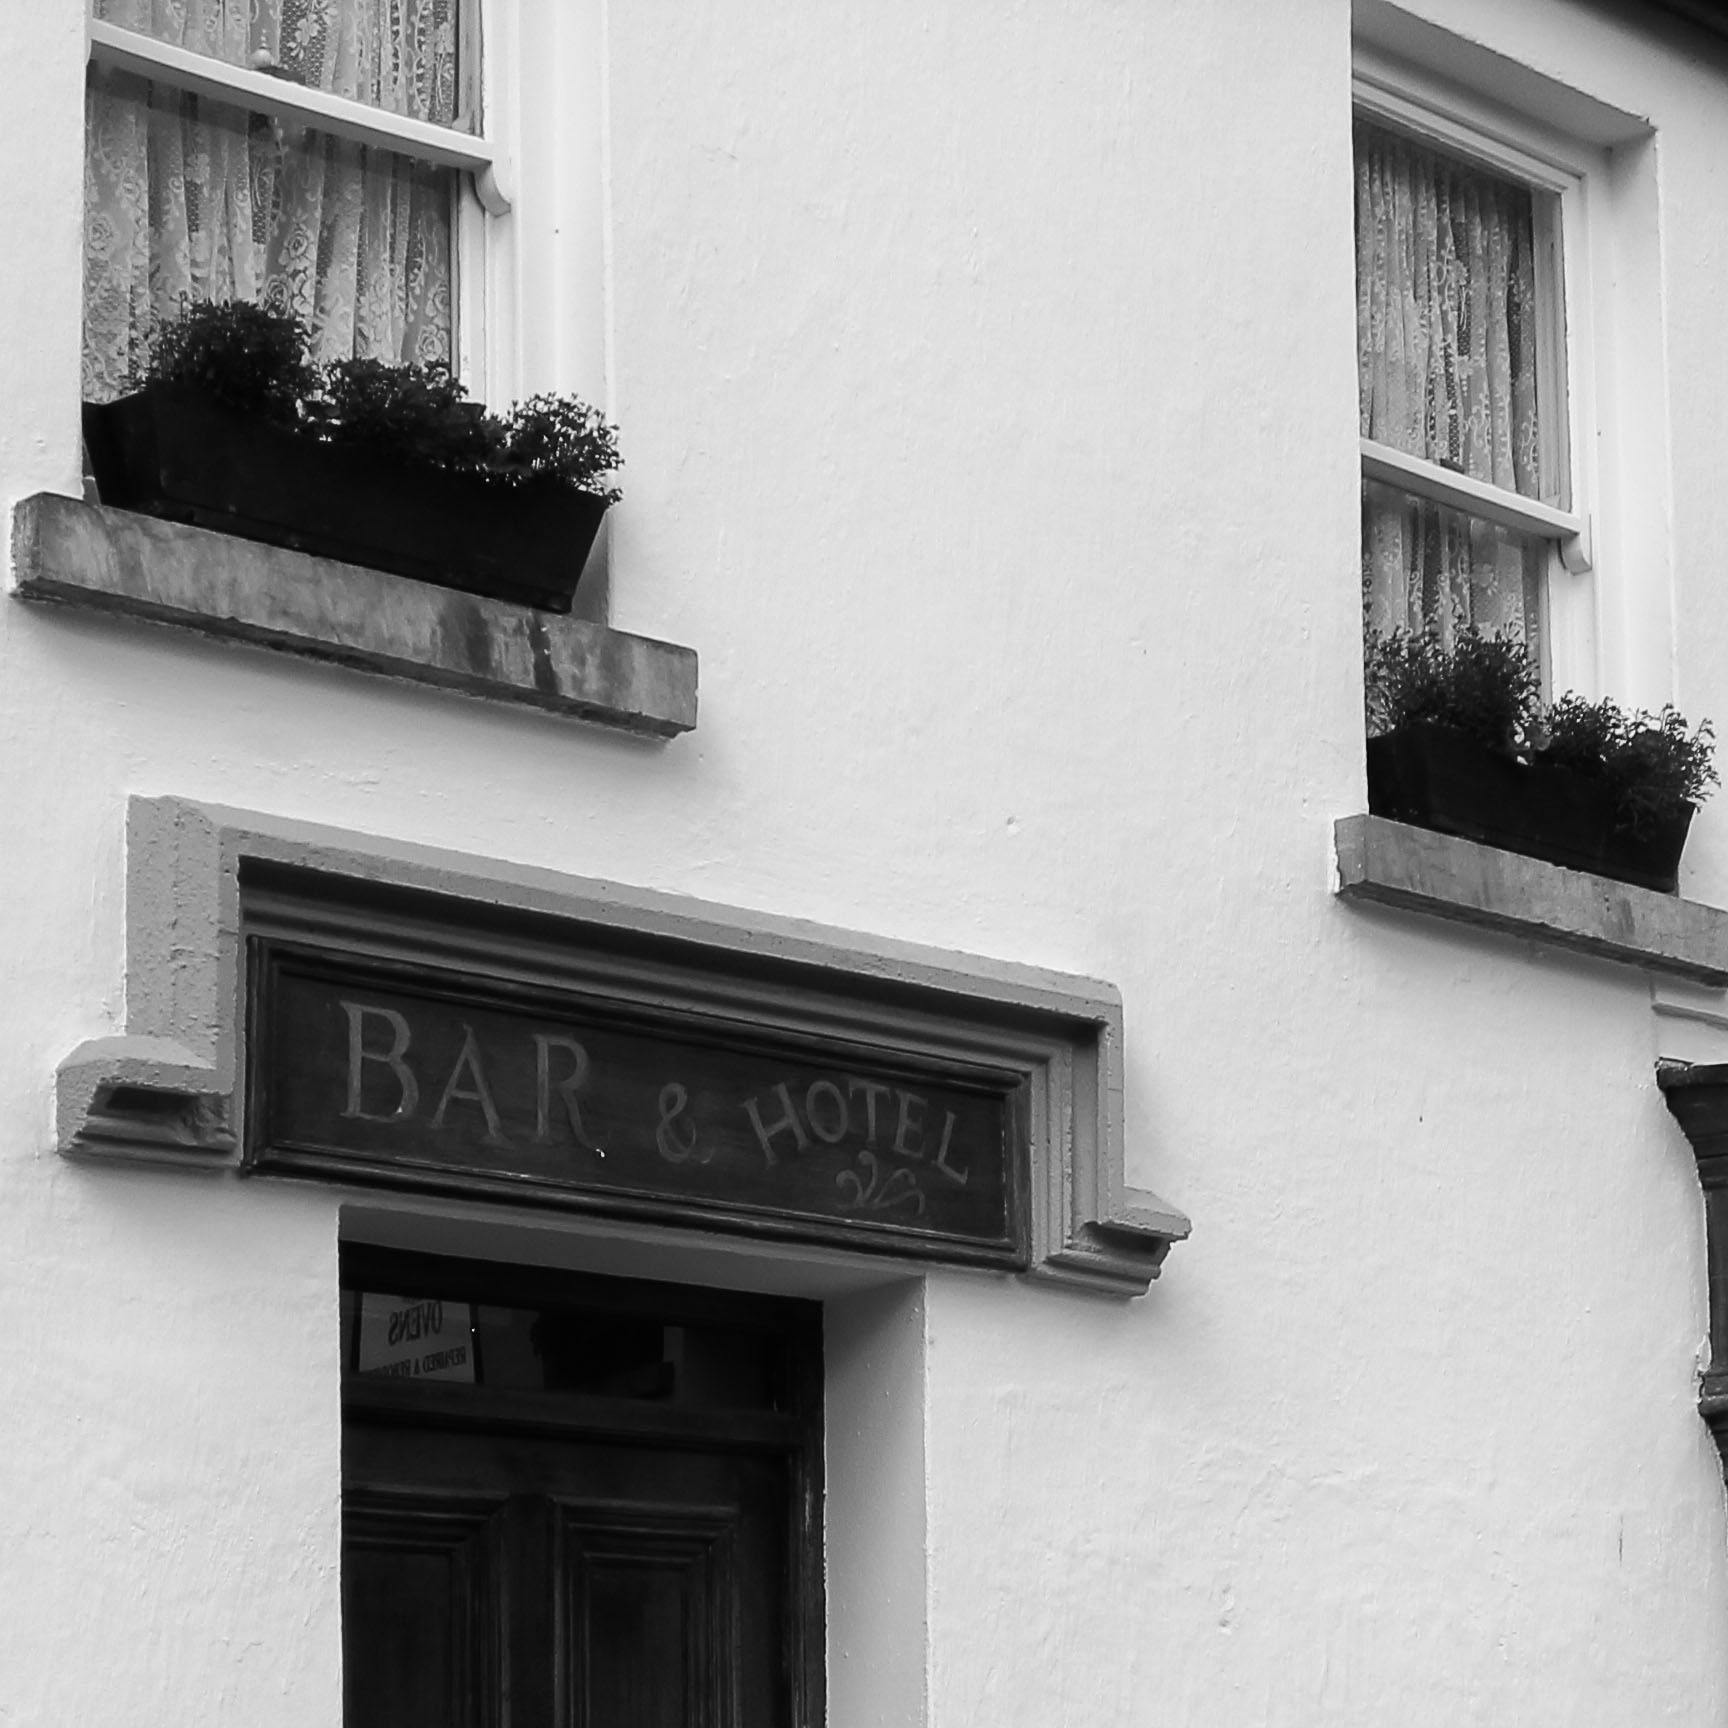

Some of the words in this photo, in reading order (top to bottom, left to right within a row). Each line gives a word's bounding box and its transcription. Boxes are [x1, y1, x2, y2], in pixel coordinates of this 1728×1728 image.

[338, 998, 604, 1156] BAR
[656, 1081, 715, 1165] &
[741, 1078, 969, 1186] HOTEL
